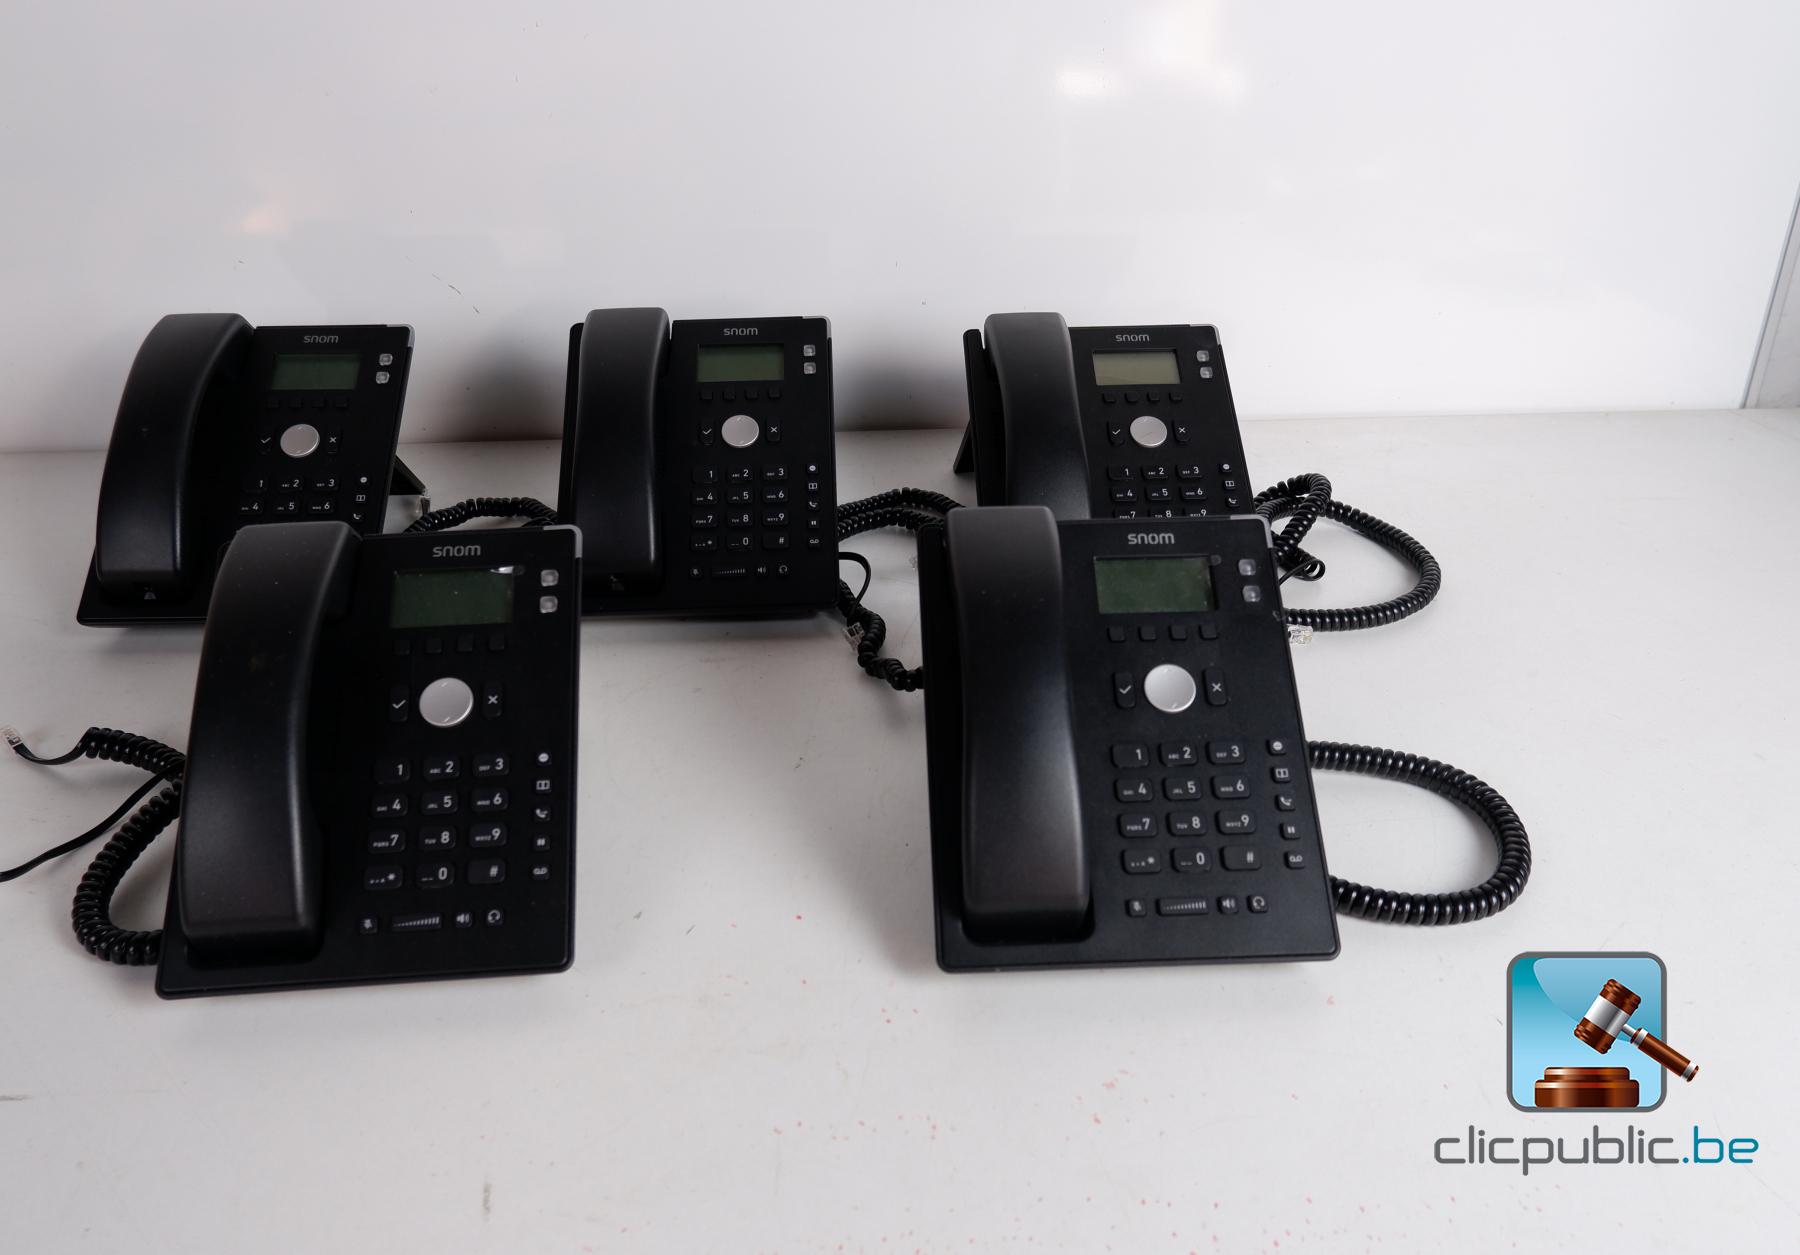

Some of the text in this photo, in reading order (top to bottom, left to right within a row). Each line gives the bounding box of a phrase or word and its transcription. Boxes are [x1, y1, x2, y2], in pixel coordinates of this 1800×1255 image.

[723, 327, 759, 336] snom
[303, 334, 339, 344] snom
[1115, 334, 1150, 342] snom
[709, 470, 713, 479] 1
[743, 468, 749, 477] 2
[778, 467, 785, 476] 3
[1124, 468, 1129, 476] 1
[1158, 466, 1165, 475] 2
[1193, 465, 1200, 475] 3
[259, 479, 264, 488] 1
[292, 478, 300, 488] 2
[328, 478, 335, 487] 3
[707, 492, 714, 501] 4
[743, 491, 749, 500] 5
[778, 490, 785, 499] 6
[1126, 489, 1134, 497] 4
[1161, 488, 1169, 497] 5
[1196, 487, 1204, 496] 6
[252, 502, 259, 511] 4
[288, 501, 295, 510] 5
[323, 501, 331, 510] 6
[707, 515, 713, 524] 7
[742, 514, 749, 523] 8
[778, 512, 785, 521] 9
[742, 536, 749, 546] 0
[1127, 532, 1176, 545] snom
[432, 544, 482, 558] snom
[1135, 748, 1142, 761] 1
[1182, 746, 1192, 759] 2
[1231, 744, 1240, 758] 3
[444, 760, 454, 773] 2
[494, 757, 504, 771] 3
[397, 763, 404, 776] 1
[1137, 782, 1147, 795] 4
[1187, 780, 1197, 794] 5
[1236, 779, 1245, 792] 6
[443, 795, 453, 808] 5
[492, 792, 503, 805] 6
[391, 798, 402, 811] 4
[1141, 817, 1151, 831] 7
[1191, 815, 1201, 829] 8
[1240, 814, 1250, 827] 9
[440, 830, 450, 844] 8
[491, 827, 501, 841] 9
[390, 833, 400, 847] 7
[1195, 851, 1206, 866] 0
[437, 866, 448, 881] 0
